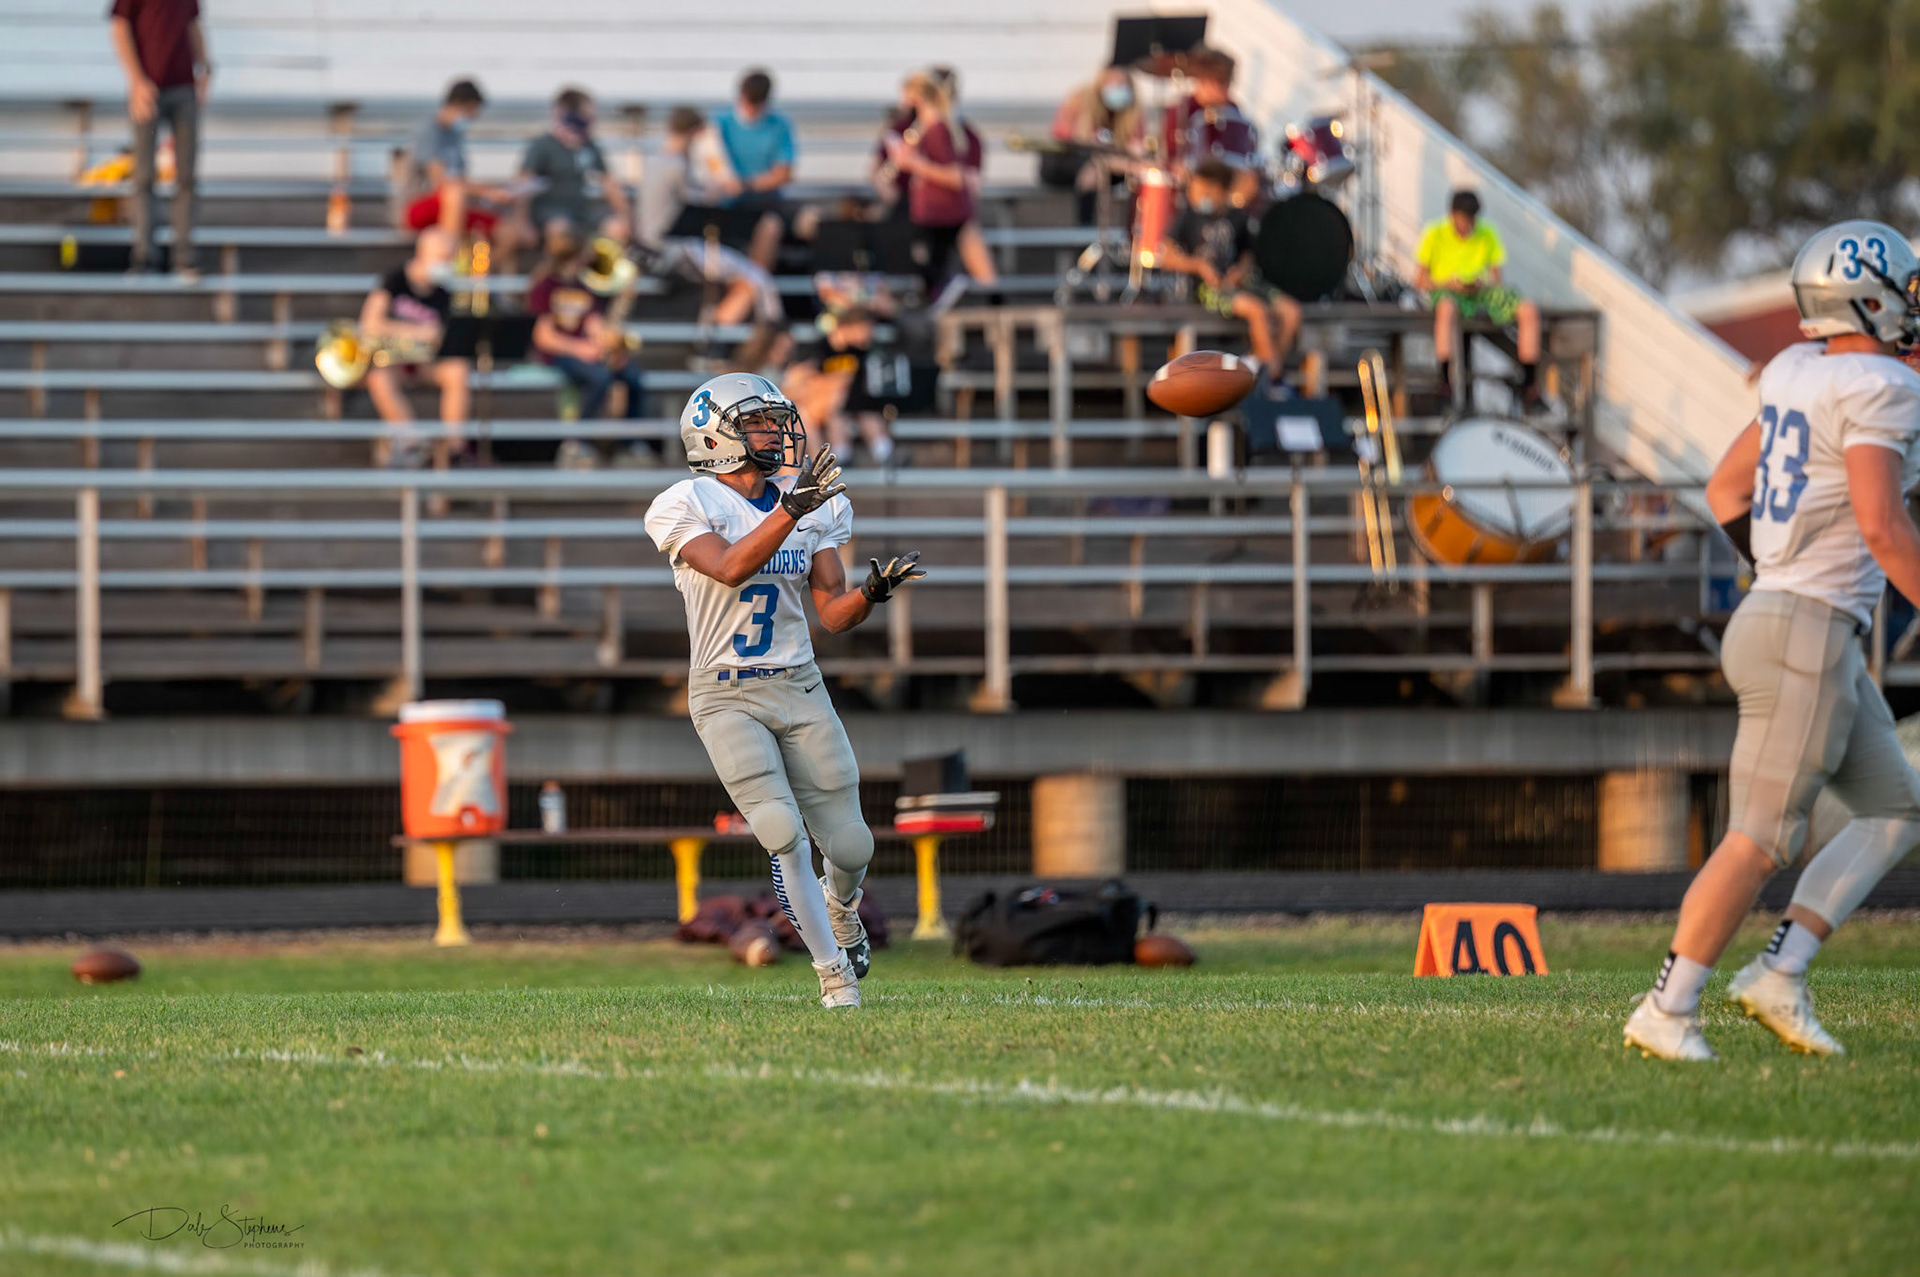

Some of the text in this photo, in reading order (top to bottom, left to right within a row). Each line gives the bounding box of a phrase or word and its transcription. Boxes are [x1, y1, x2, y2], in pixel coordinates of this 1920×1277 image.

[1839, 236, 1888, 282] 33
[691, 389, 713, 428] 3
[1751, 405, 1810, 523] 33
[733, 583, 780, 658] 3
[1451, 920, 1536, 976] 40
